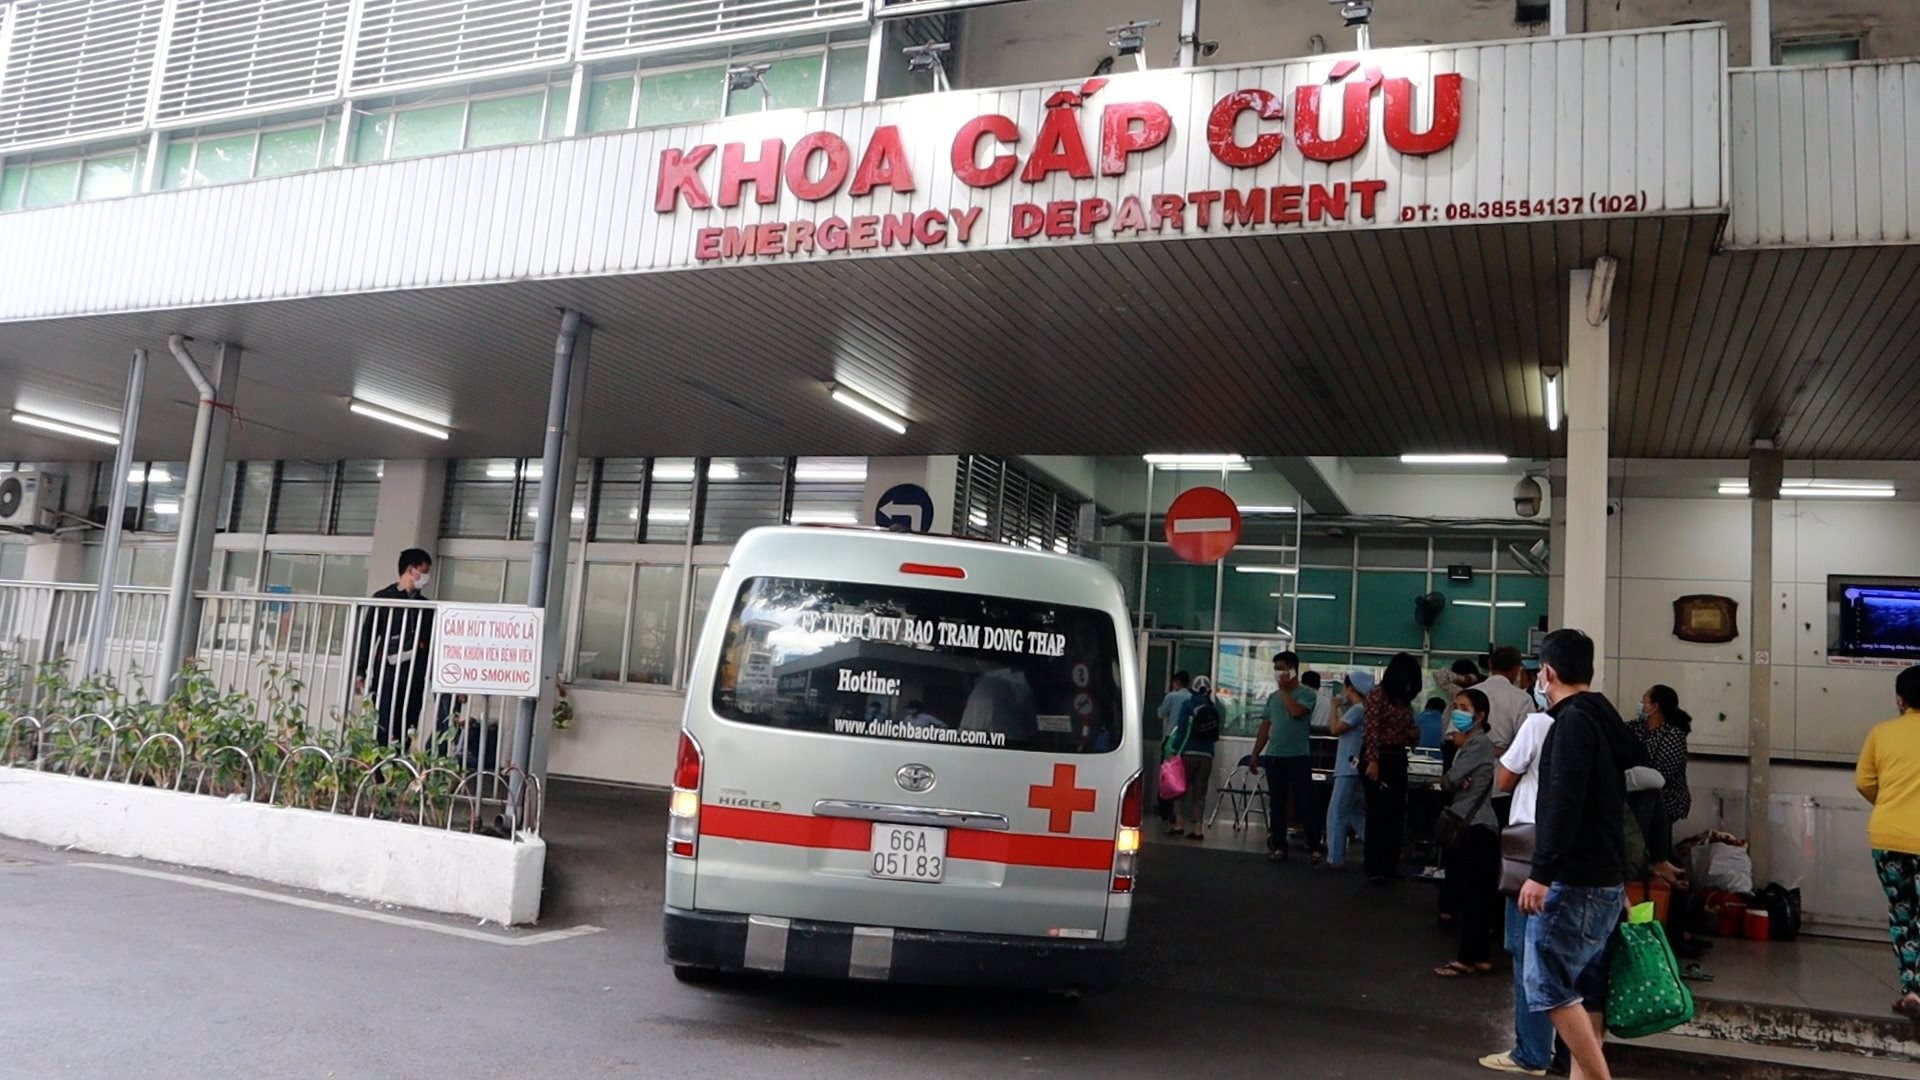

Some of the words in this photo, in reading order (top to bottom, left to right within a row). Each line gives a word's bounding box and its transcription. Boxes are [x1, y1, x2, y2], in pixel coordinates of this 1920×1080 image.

[654, 124, 915, 214] KHOA
[951, 77, 1172, 188] CẤP
[1207, 59, 1462, 169] CỨU
[1445, 197, 1584, 221] 08.38554137
[1589, 189, 1647, 214] (102)
[696, 206, 984, 261] EMERGENCY
[1011, 179, 1386, 240] DEPARTMENT
[868, 616, 902, 640] MTV
[904, 618, 934, 644] BAO
[937, 621, 981, 649] TRAM
[982, 626, 1024, 653] DONG
[1027, 630, 1066, 657] THAP
[463, 668, 478, 680] NO
[480, 669, 530, 683] SMOKING
[837, 668, 901, 696] Hotline:
[834, 717, 1006, 746] www.dulichbaotram.com.vn
[719, 796, 772, 810] HIACE
[890, 829, 927, 853] 66A
[873, 851, 941, 877] 051.83
